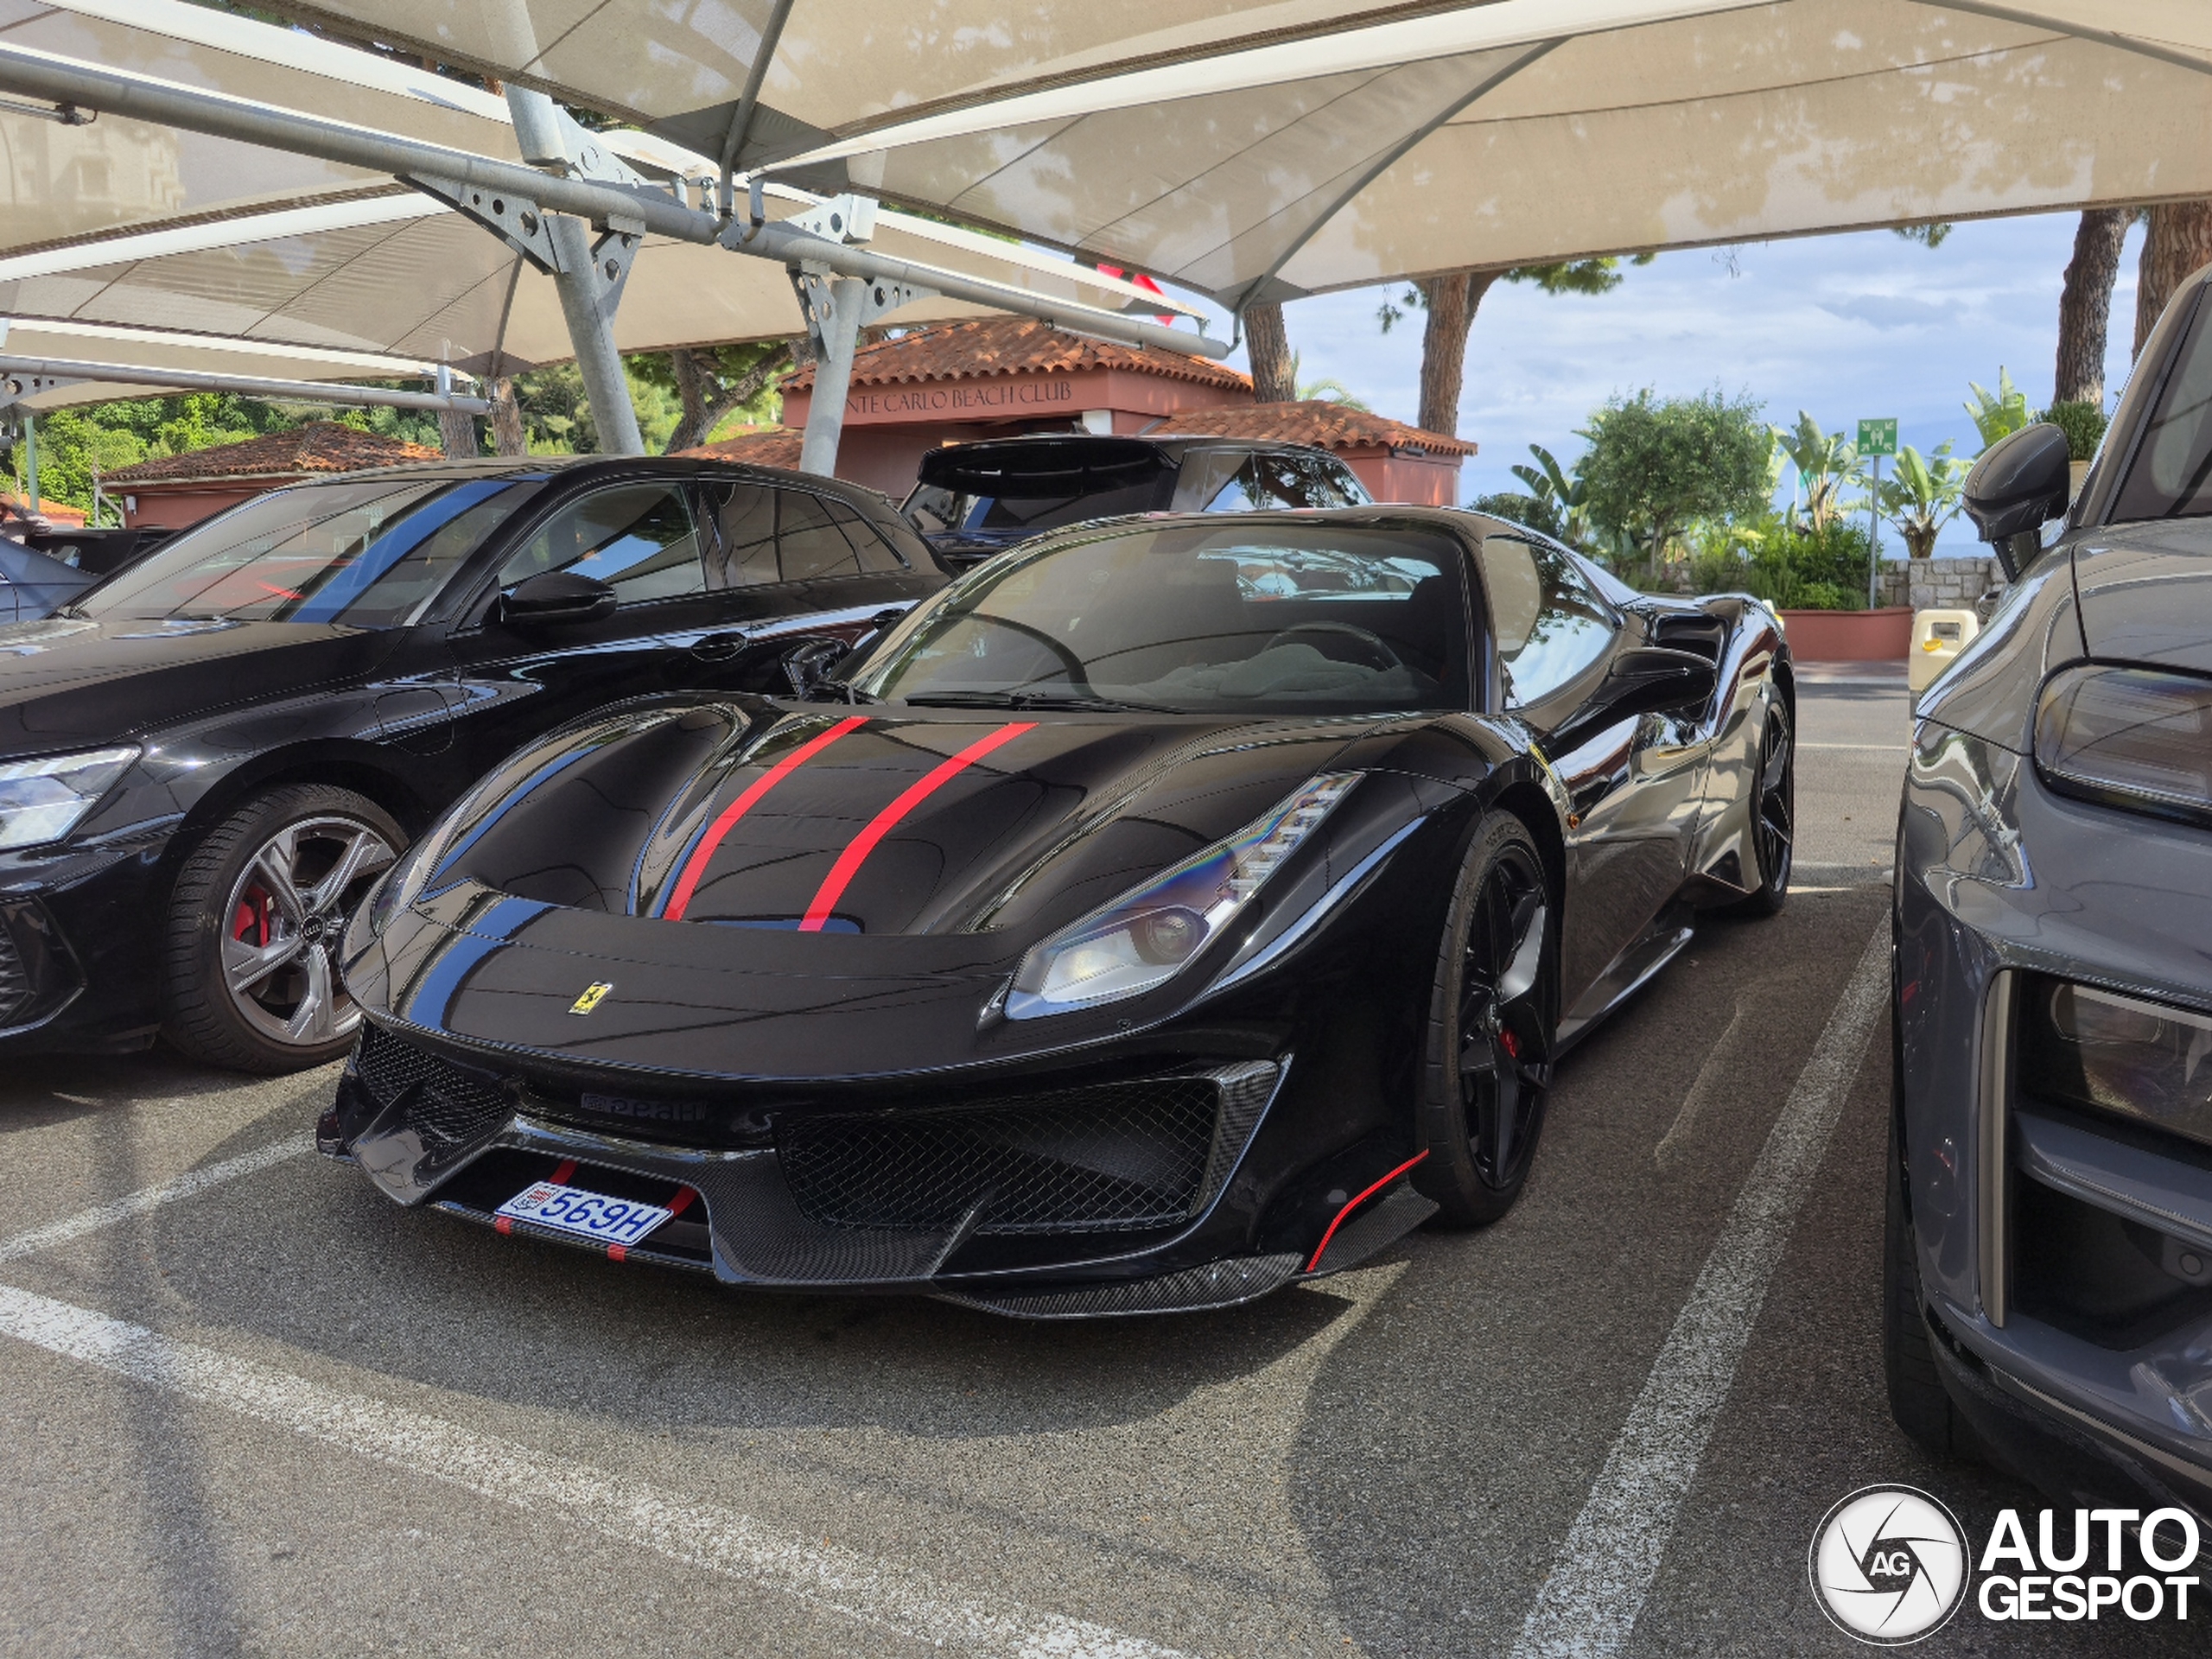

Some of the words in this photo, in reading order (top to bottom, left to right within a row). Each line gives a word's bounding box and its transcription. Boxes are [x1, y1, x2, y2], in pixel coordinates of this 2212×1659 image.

[845, 394, 880, 415] NTE
[884, 391, 947, 412] CARLO
[952, 386, 1014, 409] BEACH
[1019, 381, 1071, 403] CLUB
[540, 1192, 659, 1237] 569H
